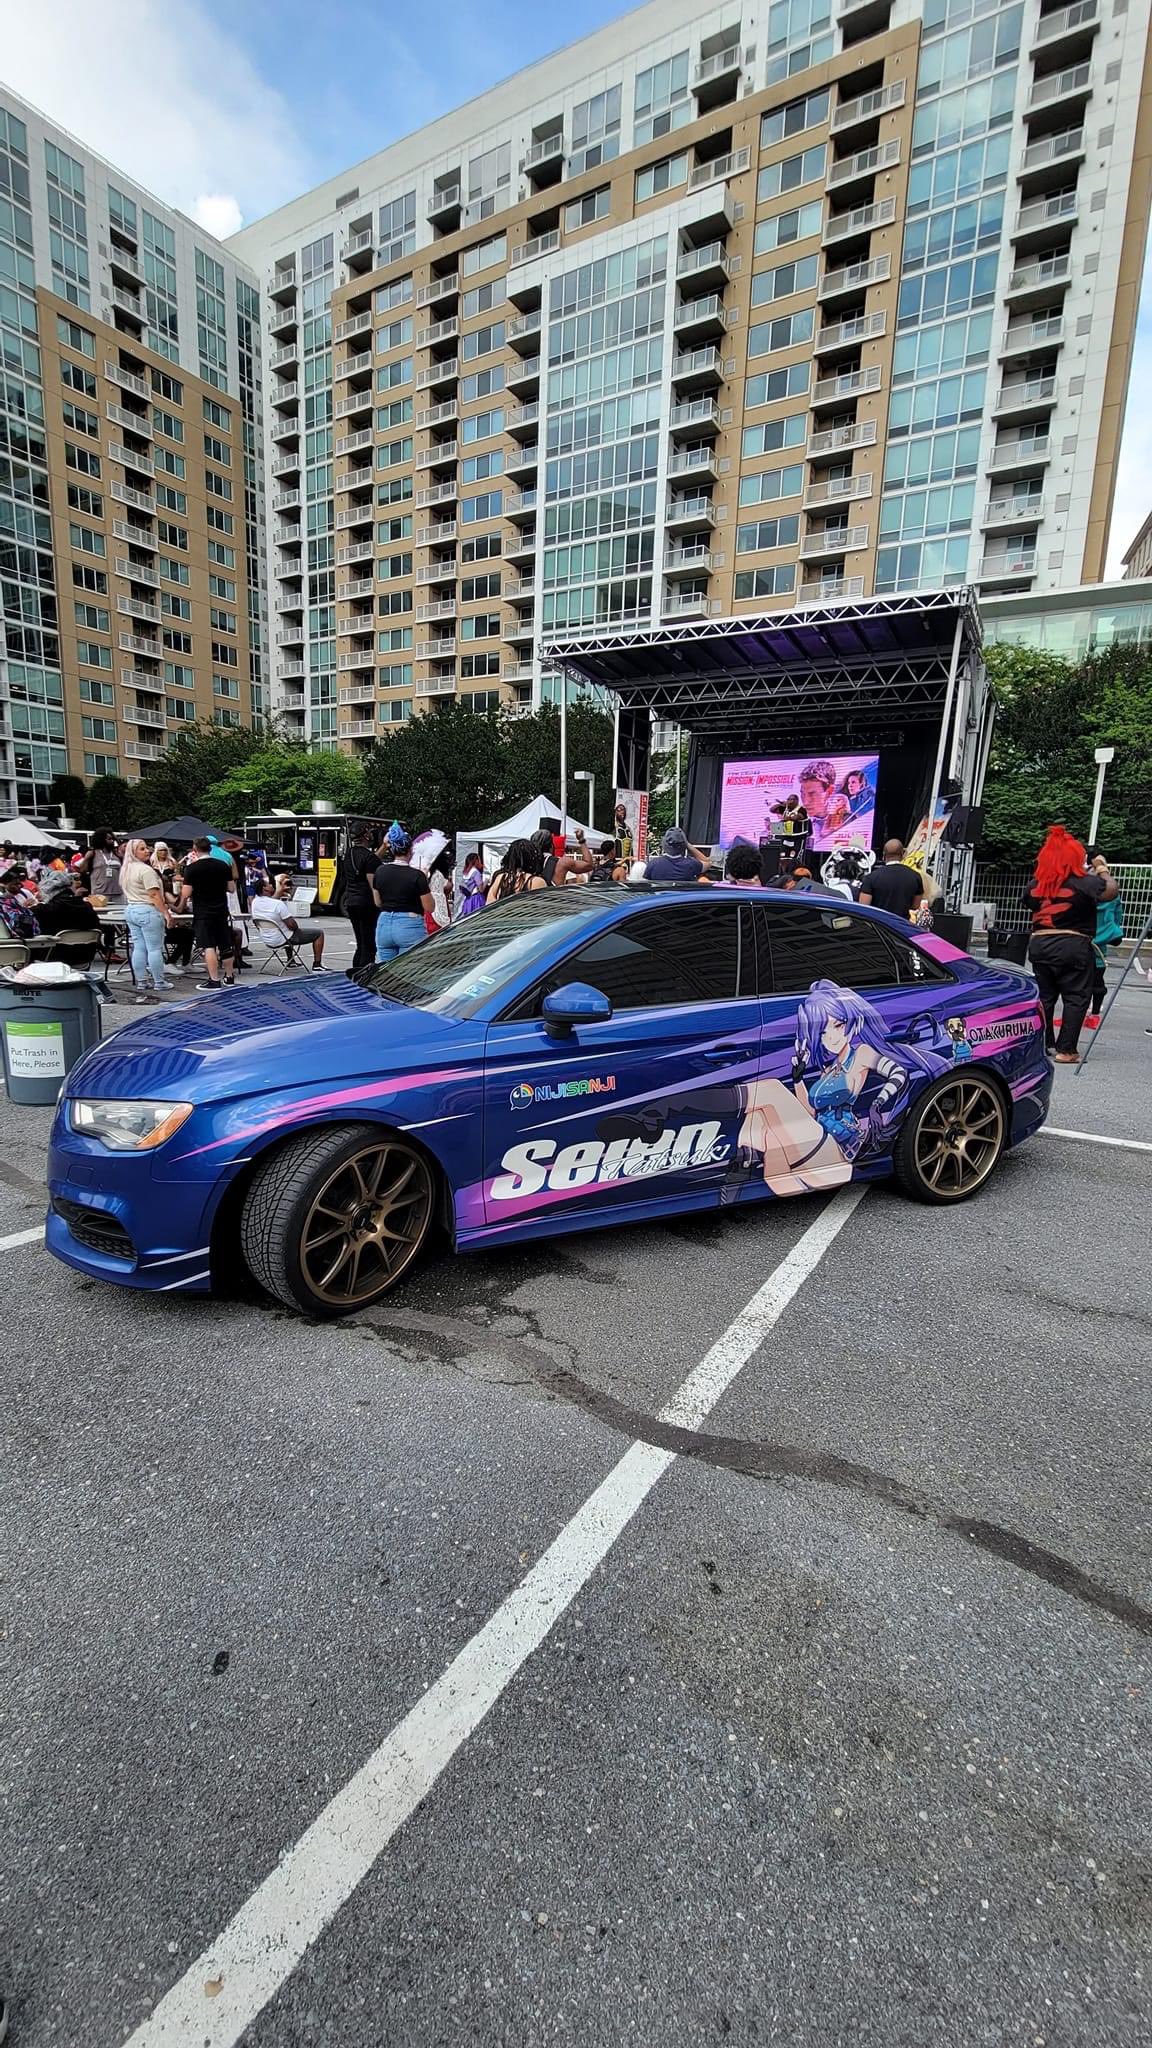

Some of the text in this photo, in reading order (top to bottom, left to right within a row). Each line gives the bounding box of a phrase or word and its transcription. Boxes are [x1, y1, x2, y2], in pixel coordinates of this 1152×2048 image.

[969, 1021, 1035, 1042] OTAKURUMA
[22, 1048, 47, 1057] Trash
[49, 1048, 58, 1056] in
[13, 1060, 61, 1068] Here, Please
[535, 1075, 616, 1102] NIJISANJI
